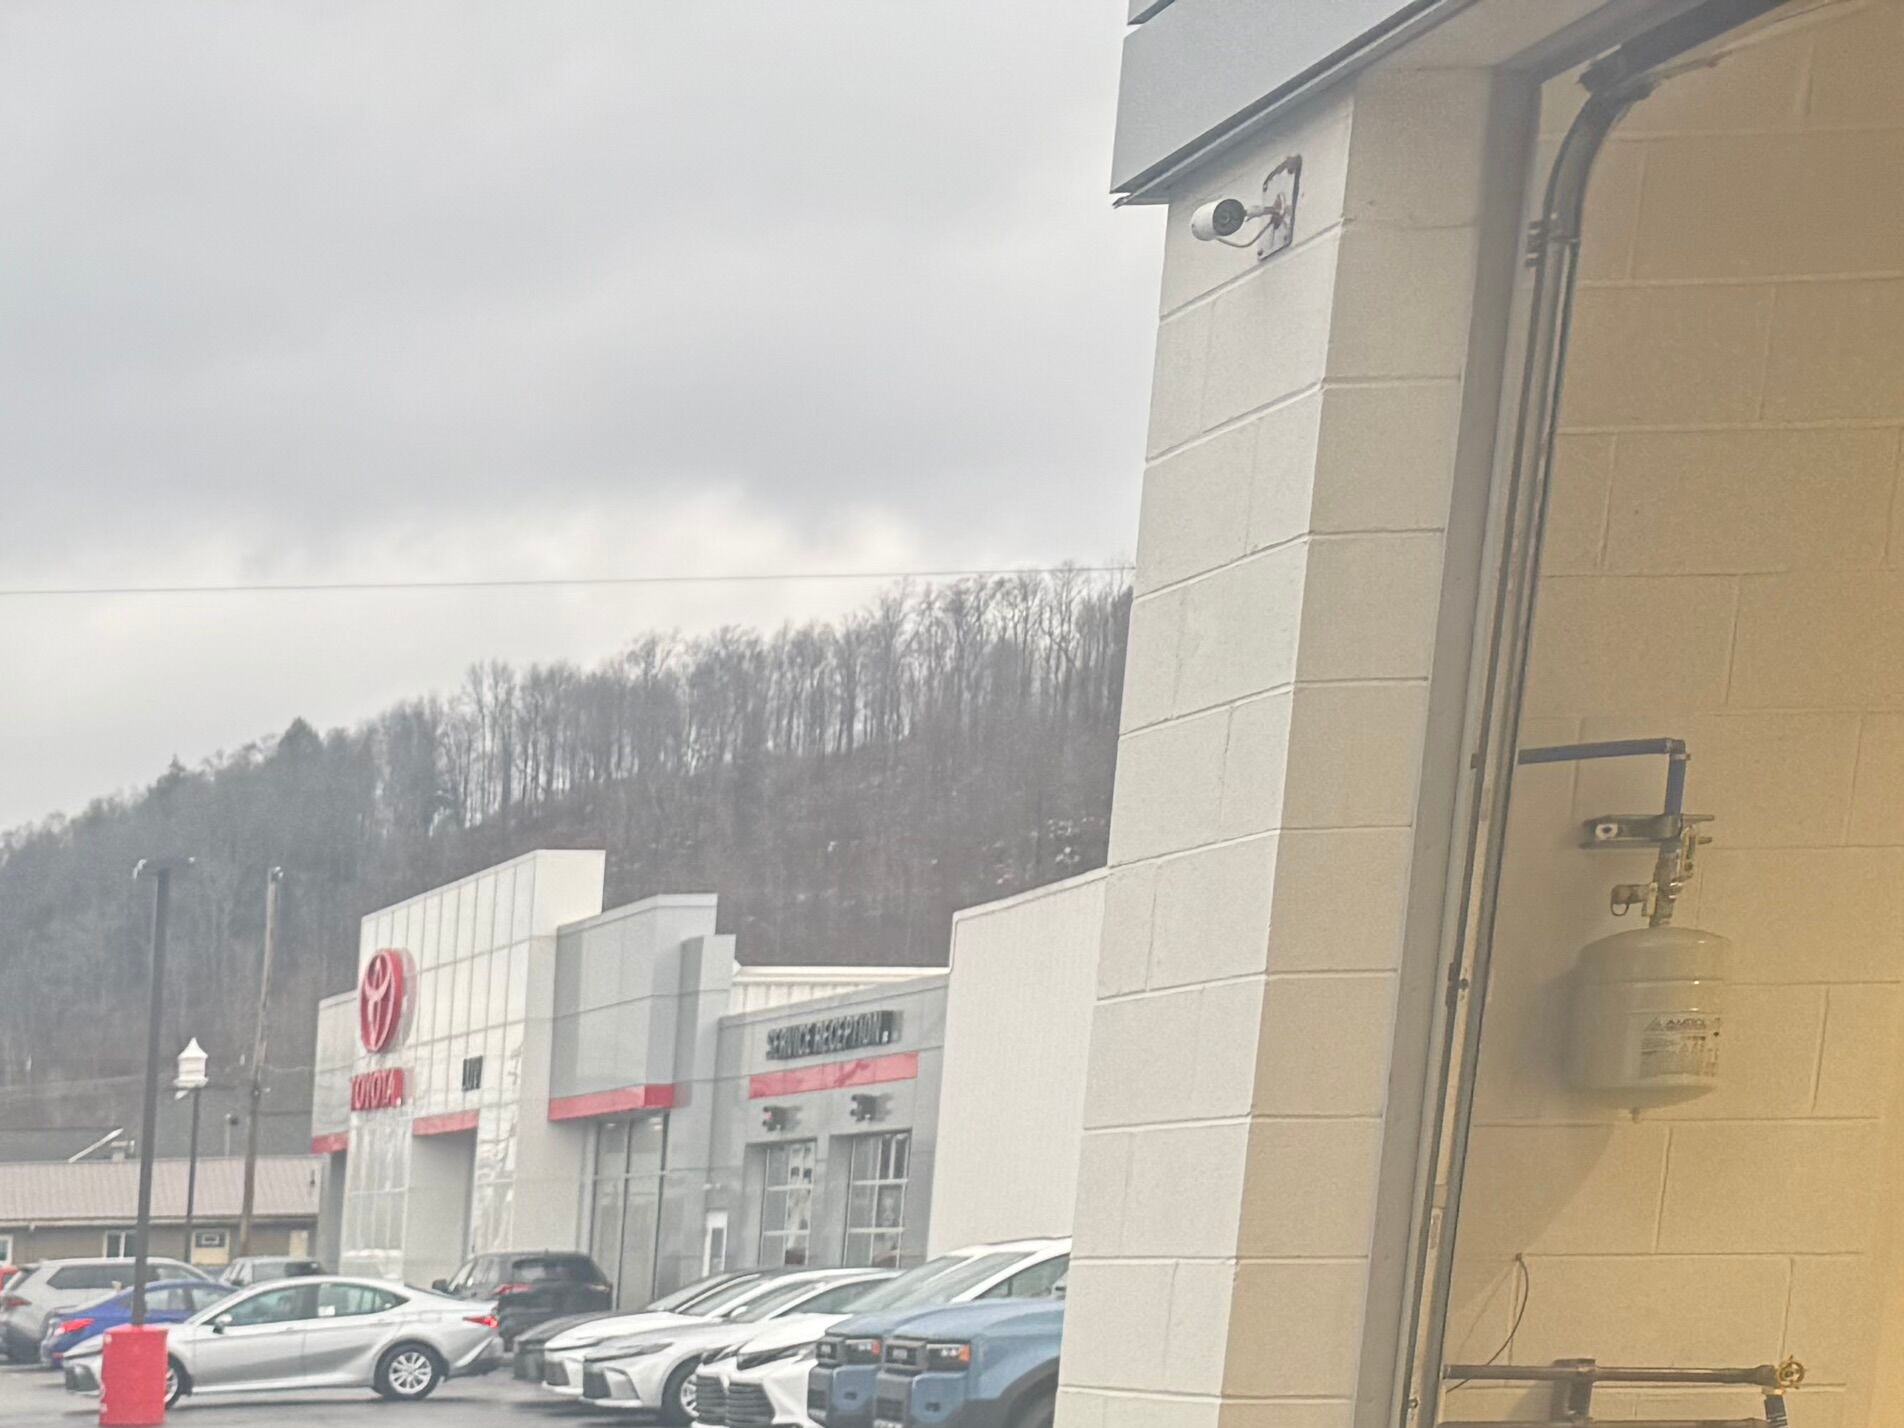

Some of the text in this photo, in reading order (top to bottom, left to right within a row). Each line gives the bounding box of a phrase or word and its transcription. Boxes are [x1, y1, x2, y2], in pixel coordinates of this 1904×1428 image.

[766, 1010, 895, 1060] SERVICE RECEPTION
[350, 1067, 404, 1112] TOYOTA
